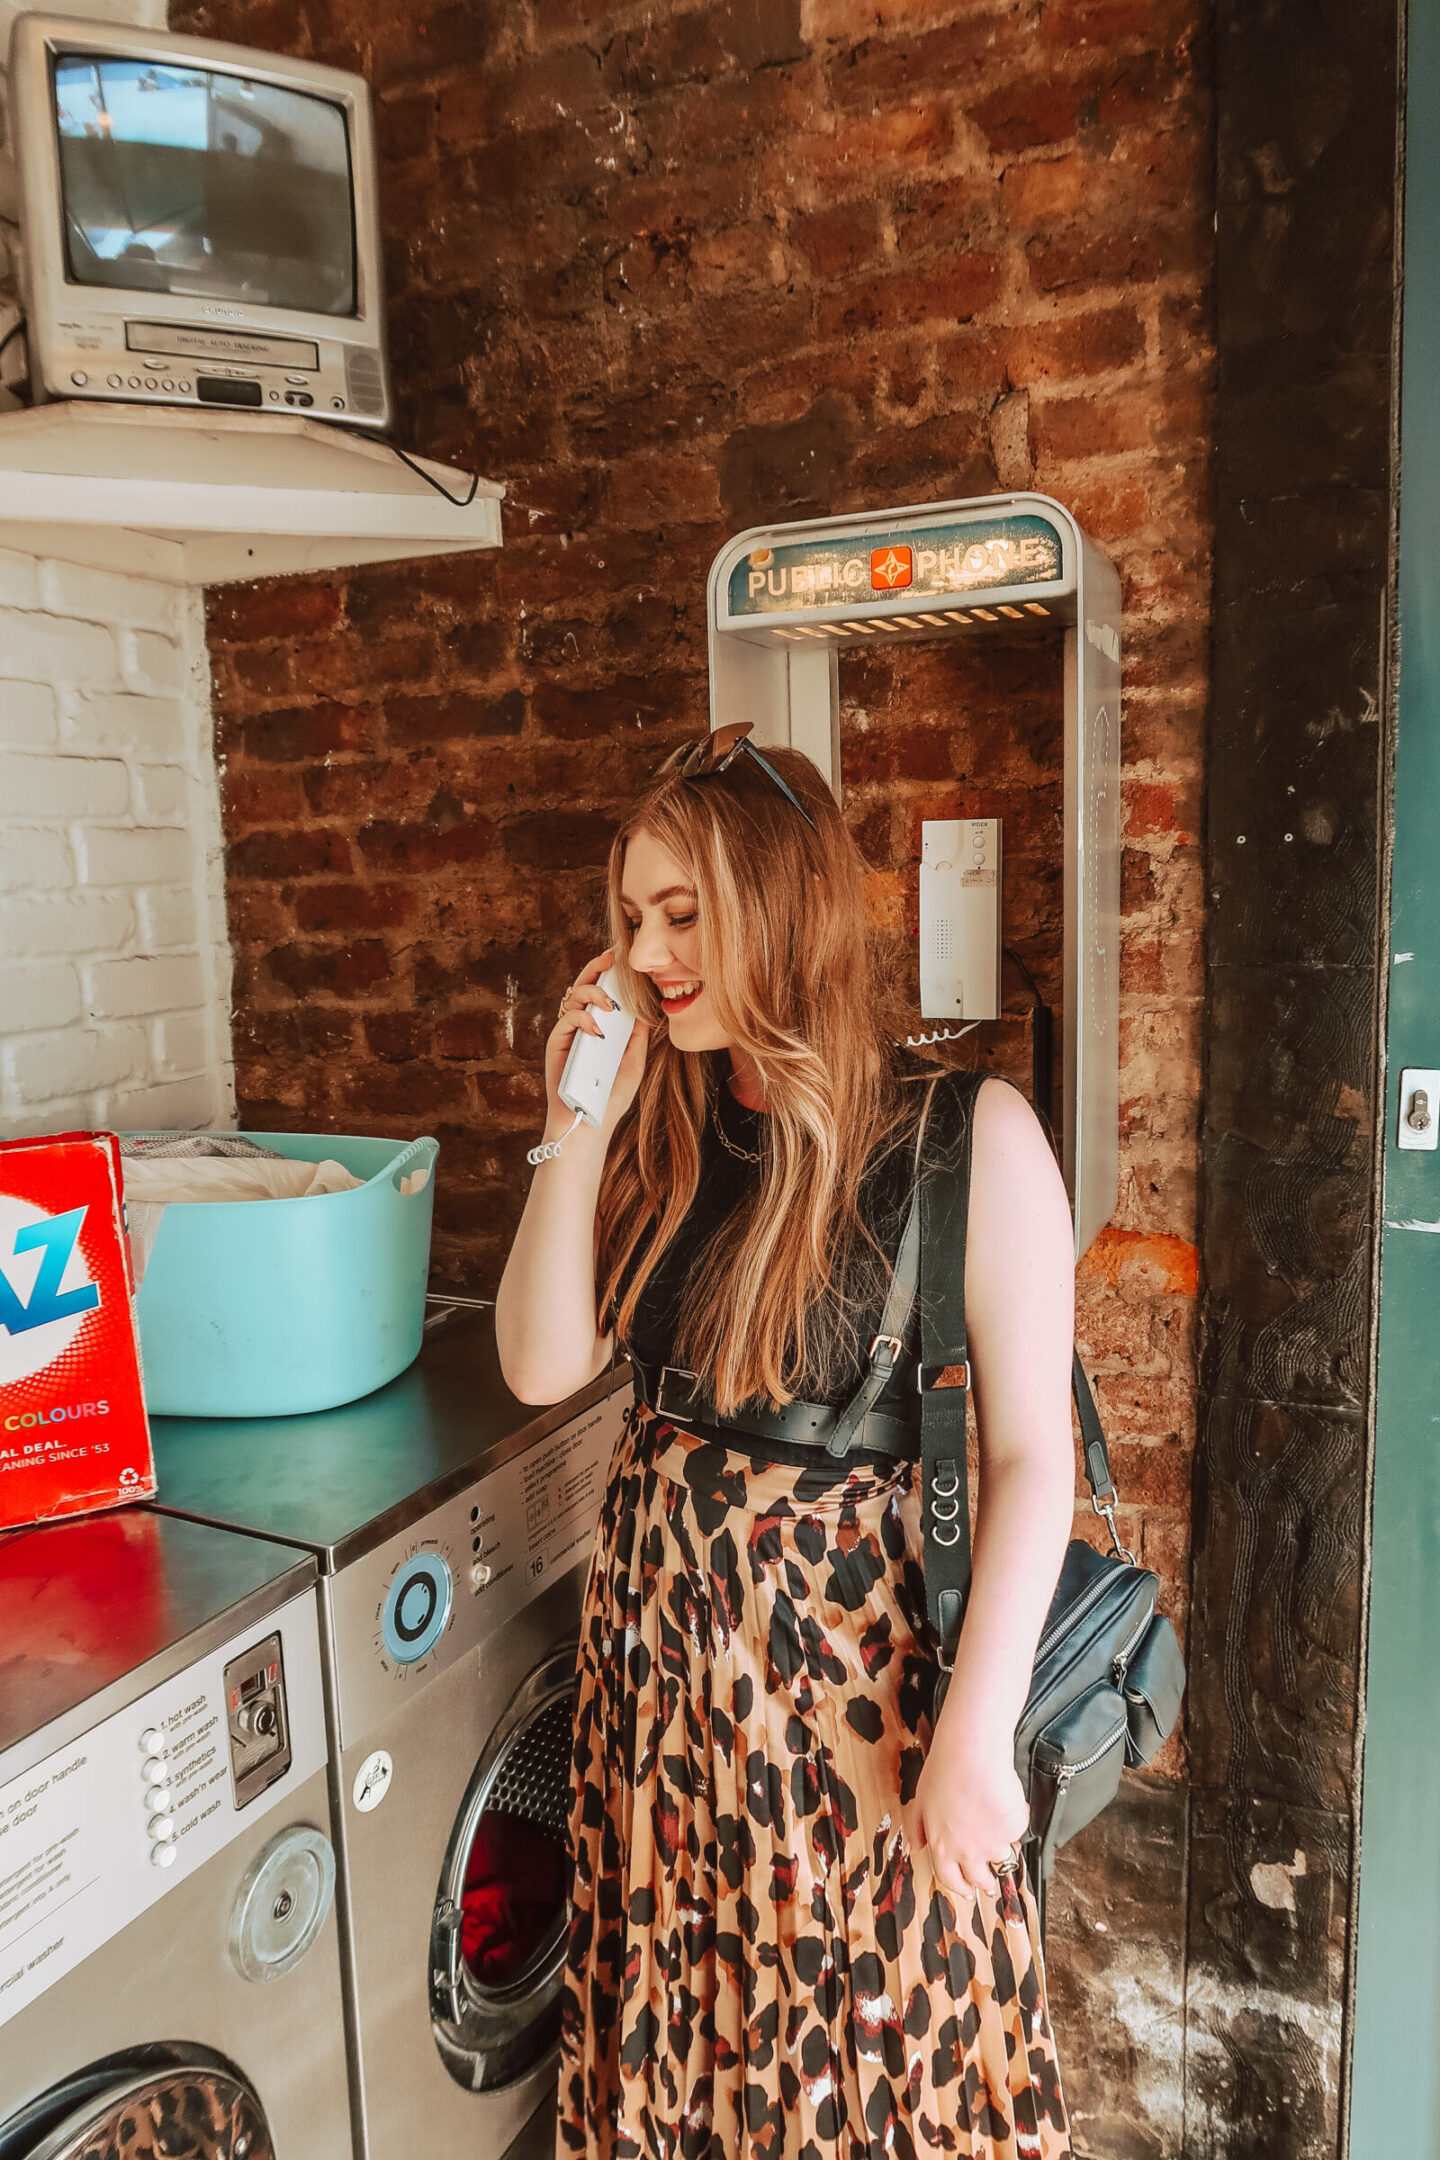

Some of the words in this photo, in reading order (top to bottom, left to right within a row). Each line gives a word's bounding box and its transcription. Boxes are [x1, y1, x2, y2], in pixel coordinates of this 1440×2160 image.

[747, 558, 864, 599] PUBLIC
[916, 539, 1044, 580] PHONE
[4, 1400, 111, 1432] COLOURS
[23, 1440, 68, 1455] DEAL.
[48, 1447, 88, 1463] SINCE
[530, 1555, 543, 1577] 16
[168, 1709, 183, 1726] hot
[184, 1695, 207, 1714] wash
[172, 1732, 196, 1753] warm
[197, 1715, 219, 1735] wash
[174, 1746, 217, 1782] synthetics
[207, 1766, 228, 1785] wear
[24, 1779, 50, 1803] door
[12, 1803, 38, 1828] door
[180, 1816, 199, 1836] cold
[200, 1799, 222, 1820] wash
